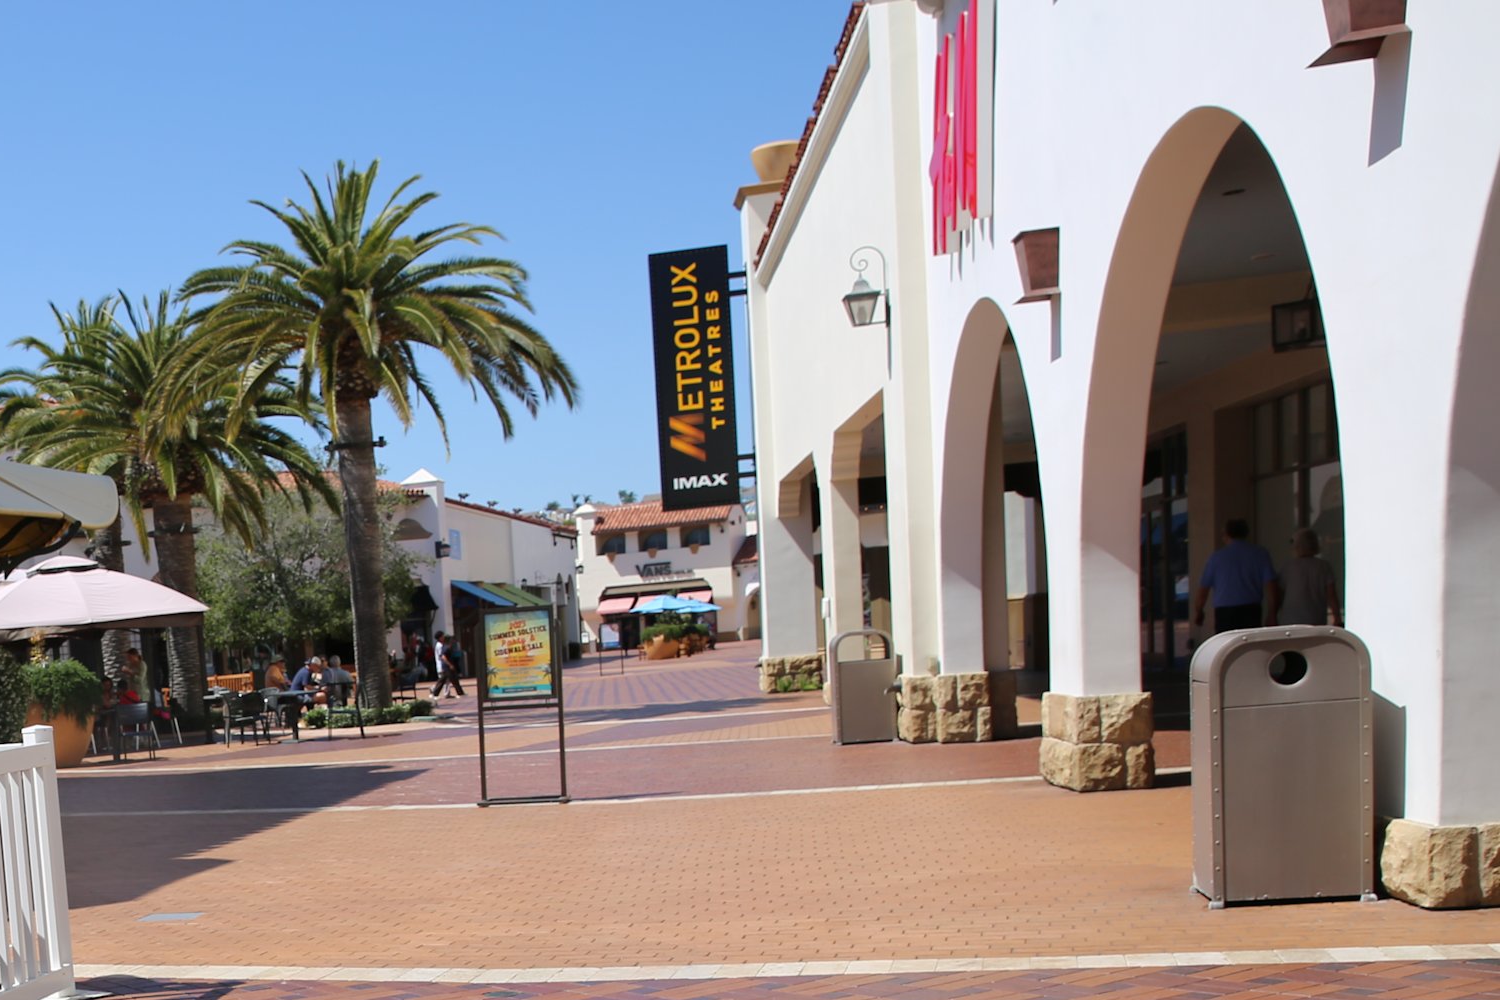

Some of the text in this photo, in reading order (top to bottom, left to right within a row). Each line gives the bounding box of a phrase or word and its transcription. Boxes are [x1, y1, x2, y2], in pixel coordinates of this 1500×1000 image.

[669, 262, 707, 462] METROLUX
[705, 290, 726, 430] THEATRES
[673, 472, 729, 490] IMAX
[635, 561, 672, 577] VANS
